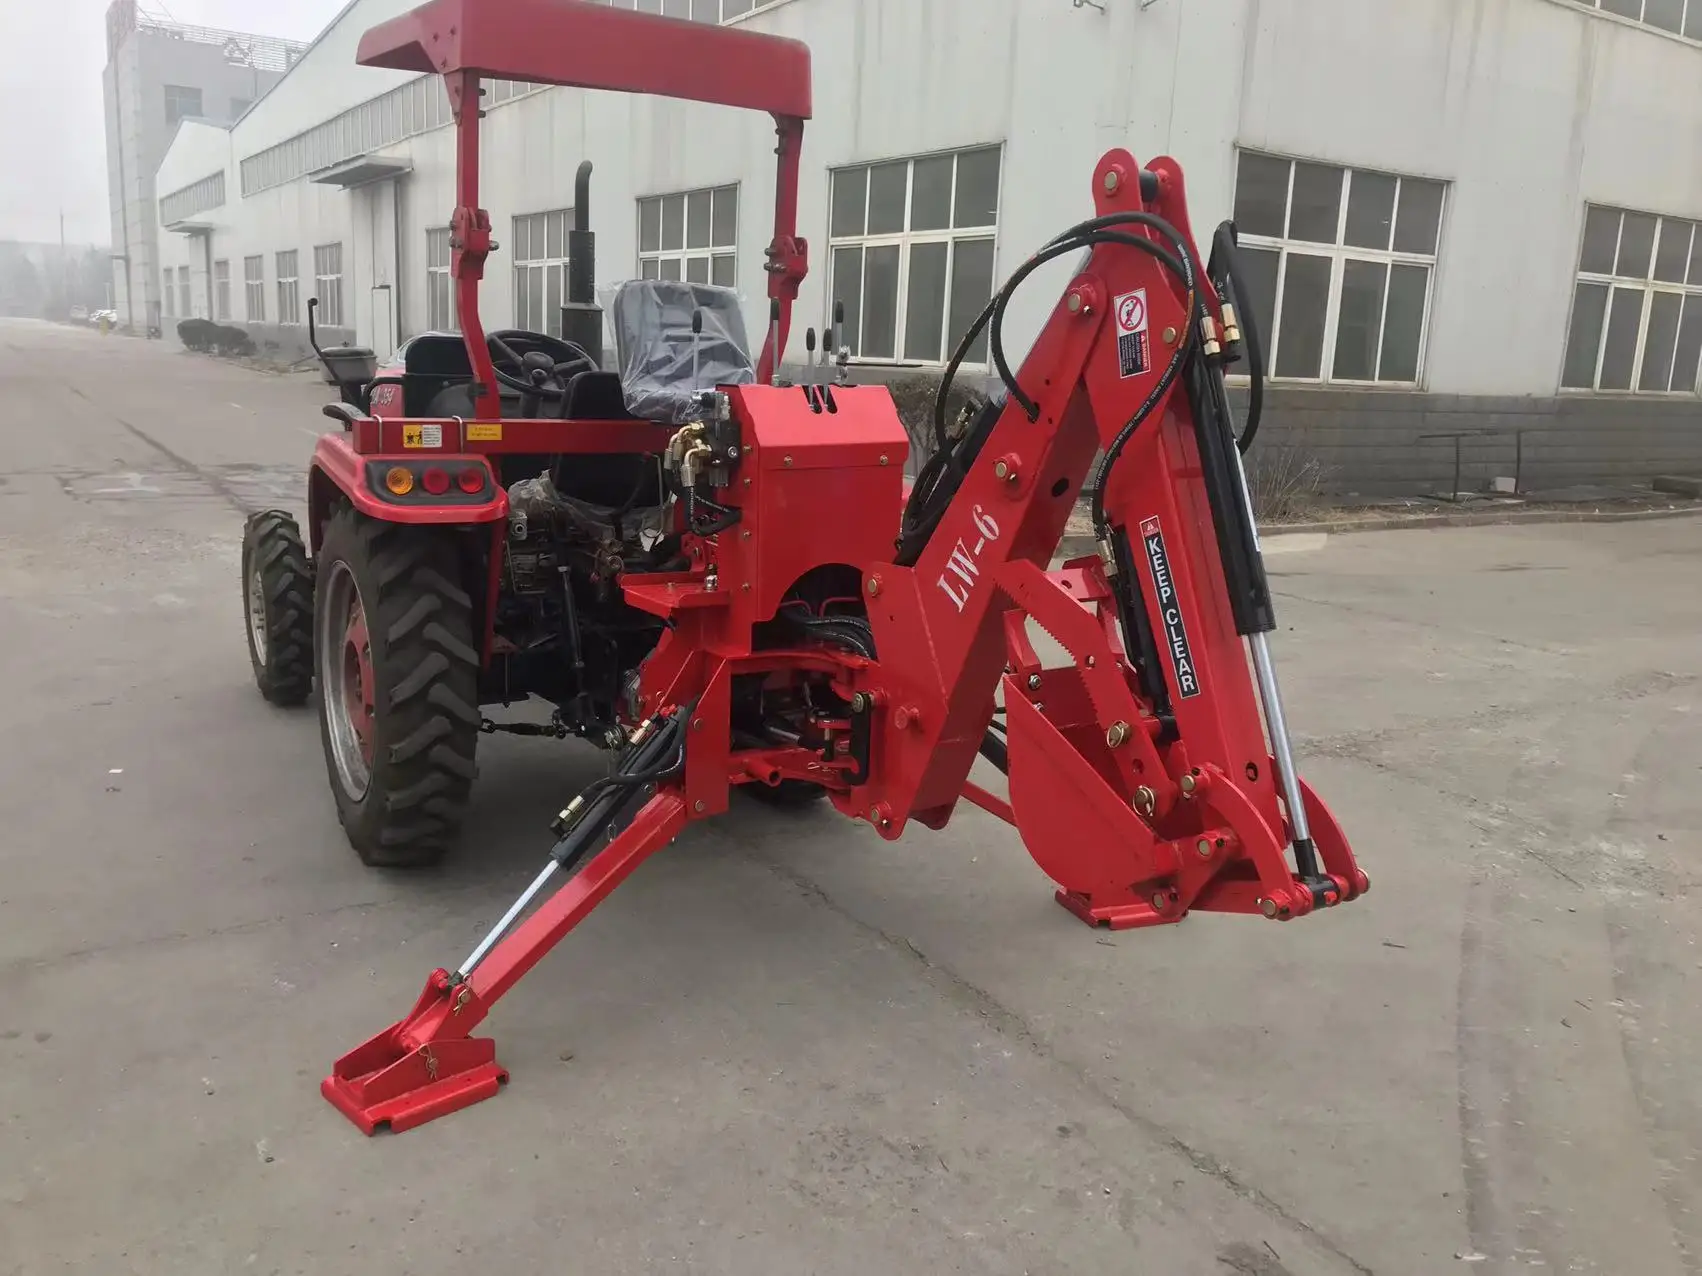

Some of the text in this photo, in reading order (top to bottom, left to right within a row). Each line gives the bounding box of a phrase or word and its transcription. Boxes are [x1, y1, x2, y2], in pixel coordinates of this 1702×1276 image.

[937, 504, 1000, 613] LW-6
[1148, 537, 1171, 604] KEEP
[1166, 608, 1195, 692] CLEAR
